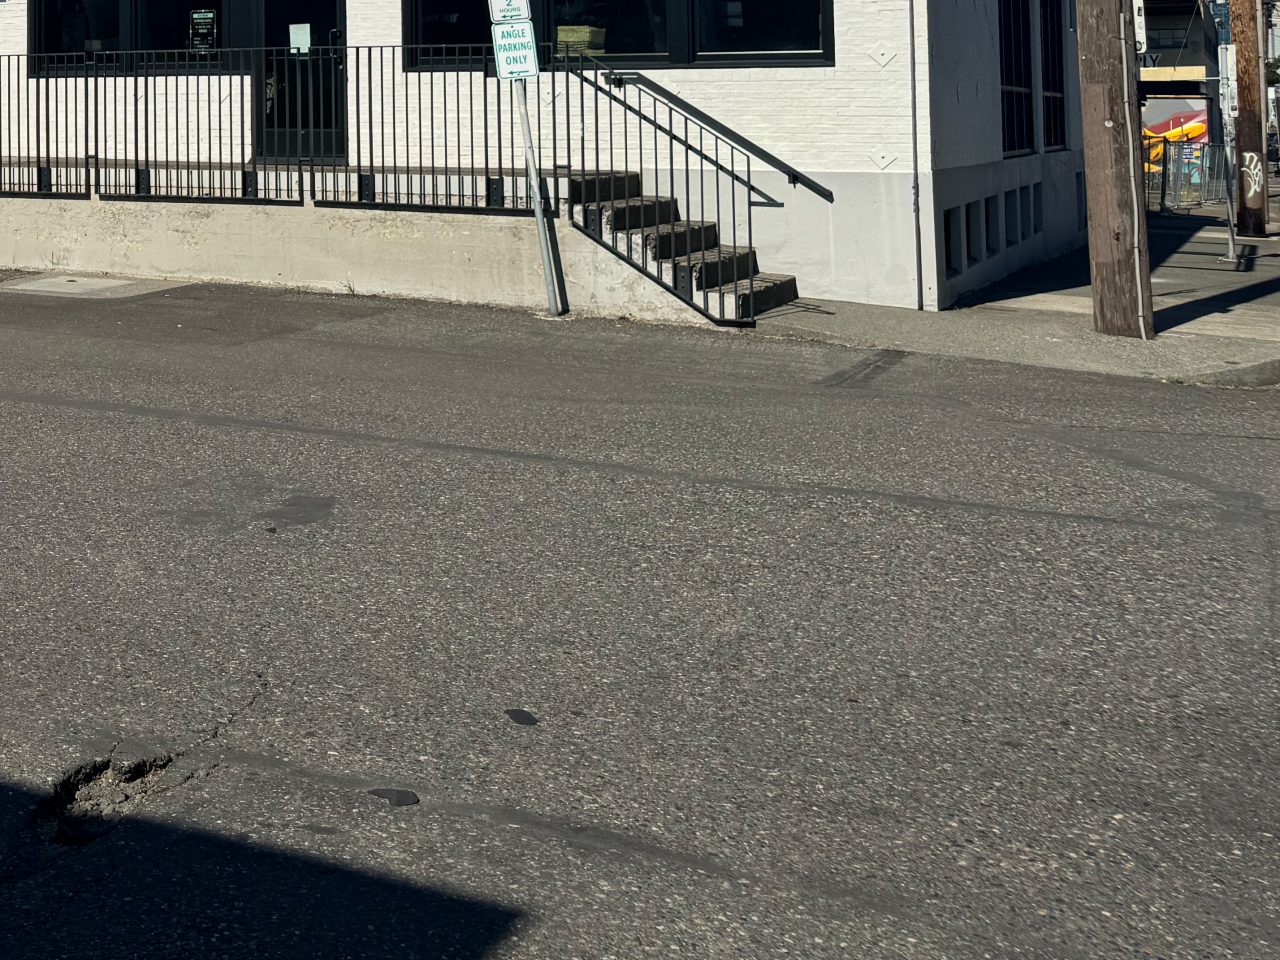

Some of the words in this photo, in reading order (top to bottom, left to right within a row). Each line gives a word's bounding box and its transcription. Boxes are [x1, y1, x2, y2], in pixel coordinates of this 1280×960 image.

[499, 6, 521, 14] HOURS
[501, 28, 526, 39] ANGLE
[498, 41, 532, 53] PARKING
[506, 55, 528, 66] ONLY
